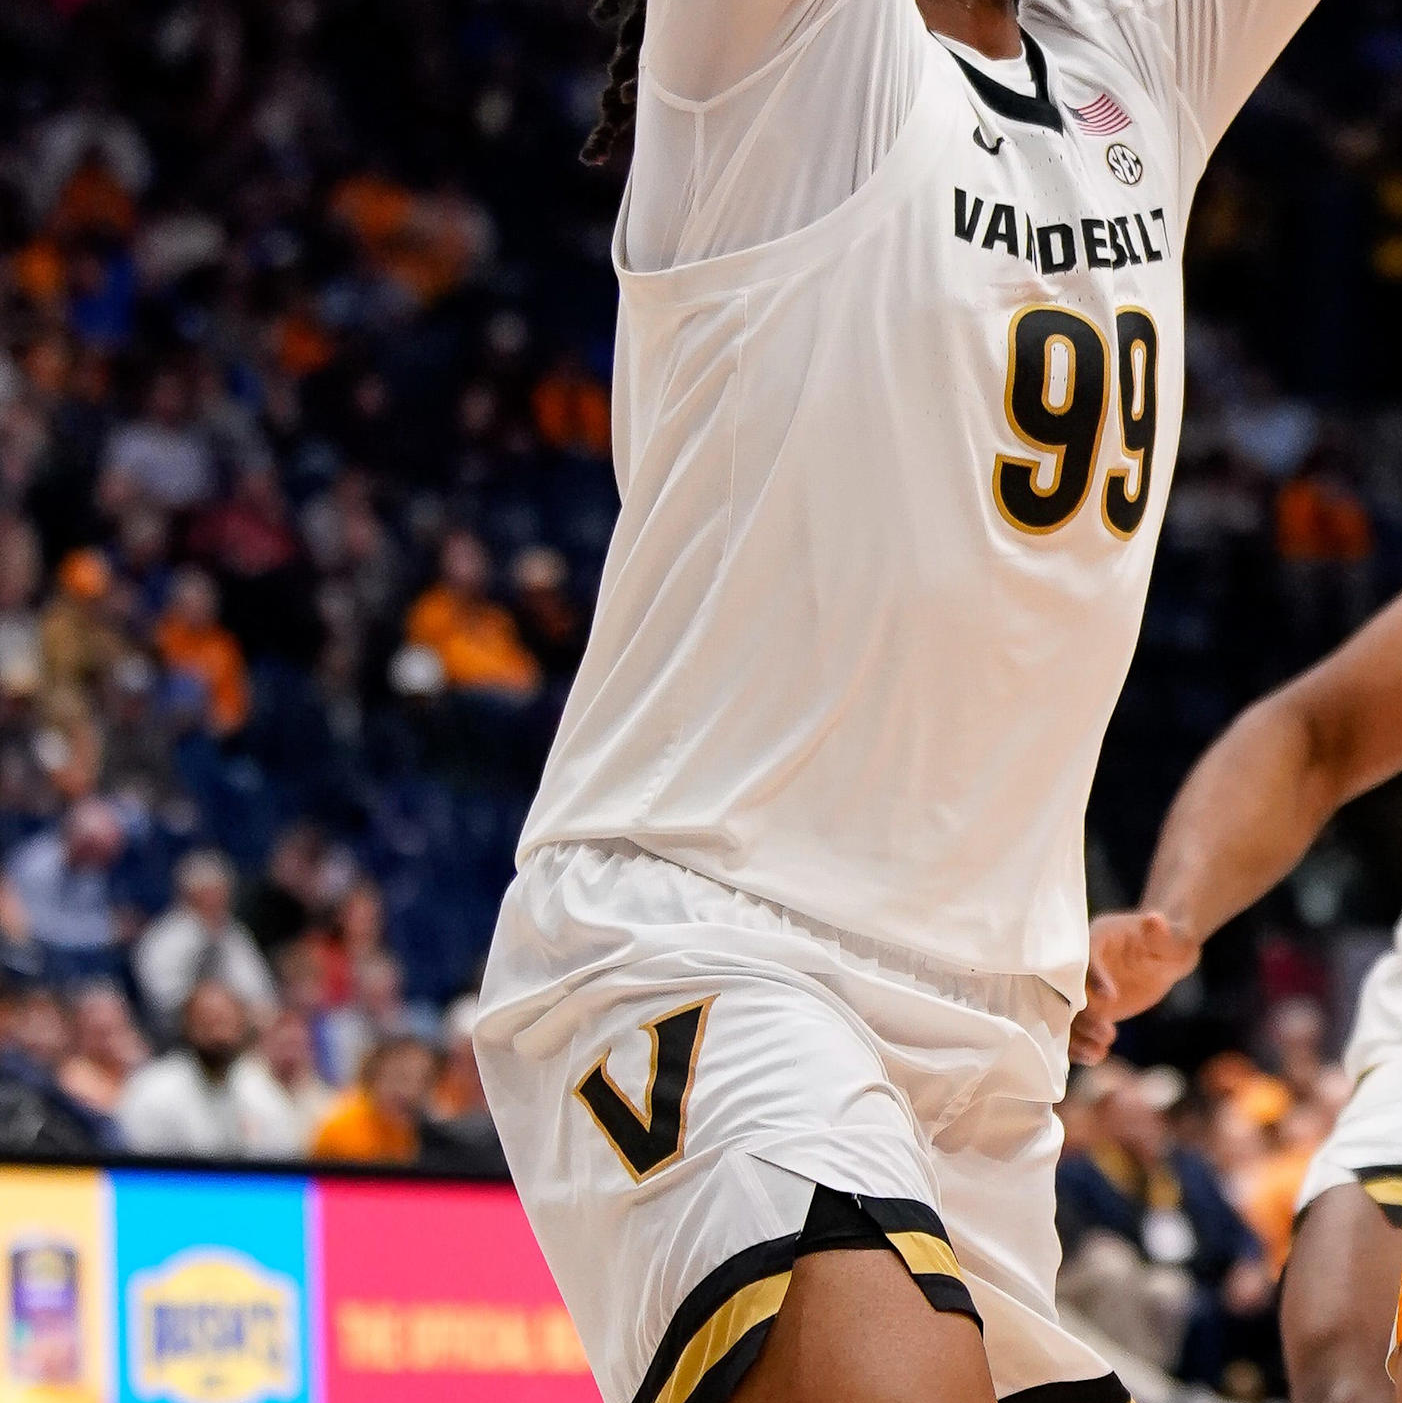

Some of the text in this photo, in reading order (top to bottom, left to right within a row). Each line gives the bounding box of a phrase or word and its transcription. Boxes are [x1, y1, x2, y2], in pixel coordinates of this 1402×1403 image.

[1107, 144, 1142, 184] SEC
[992, 303, 1159, 541] 99
[573, 994, 720, 1185] V
